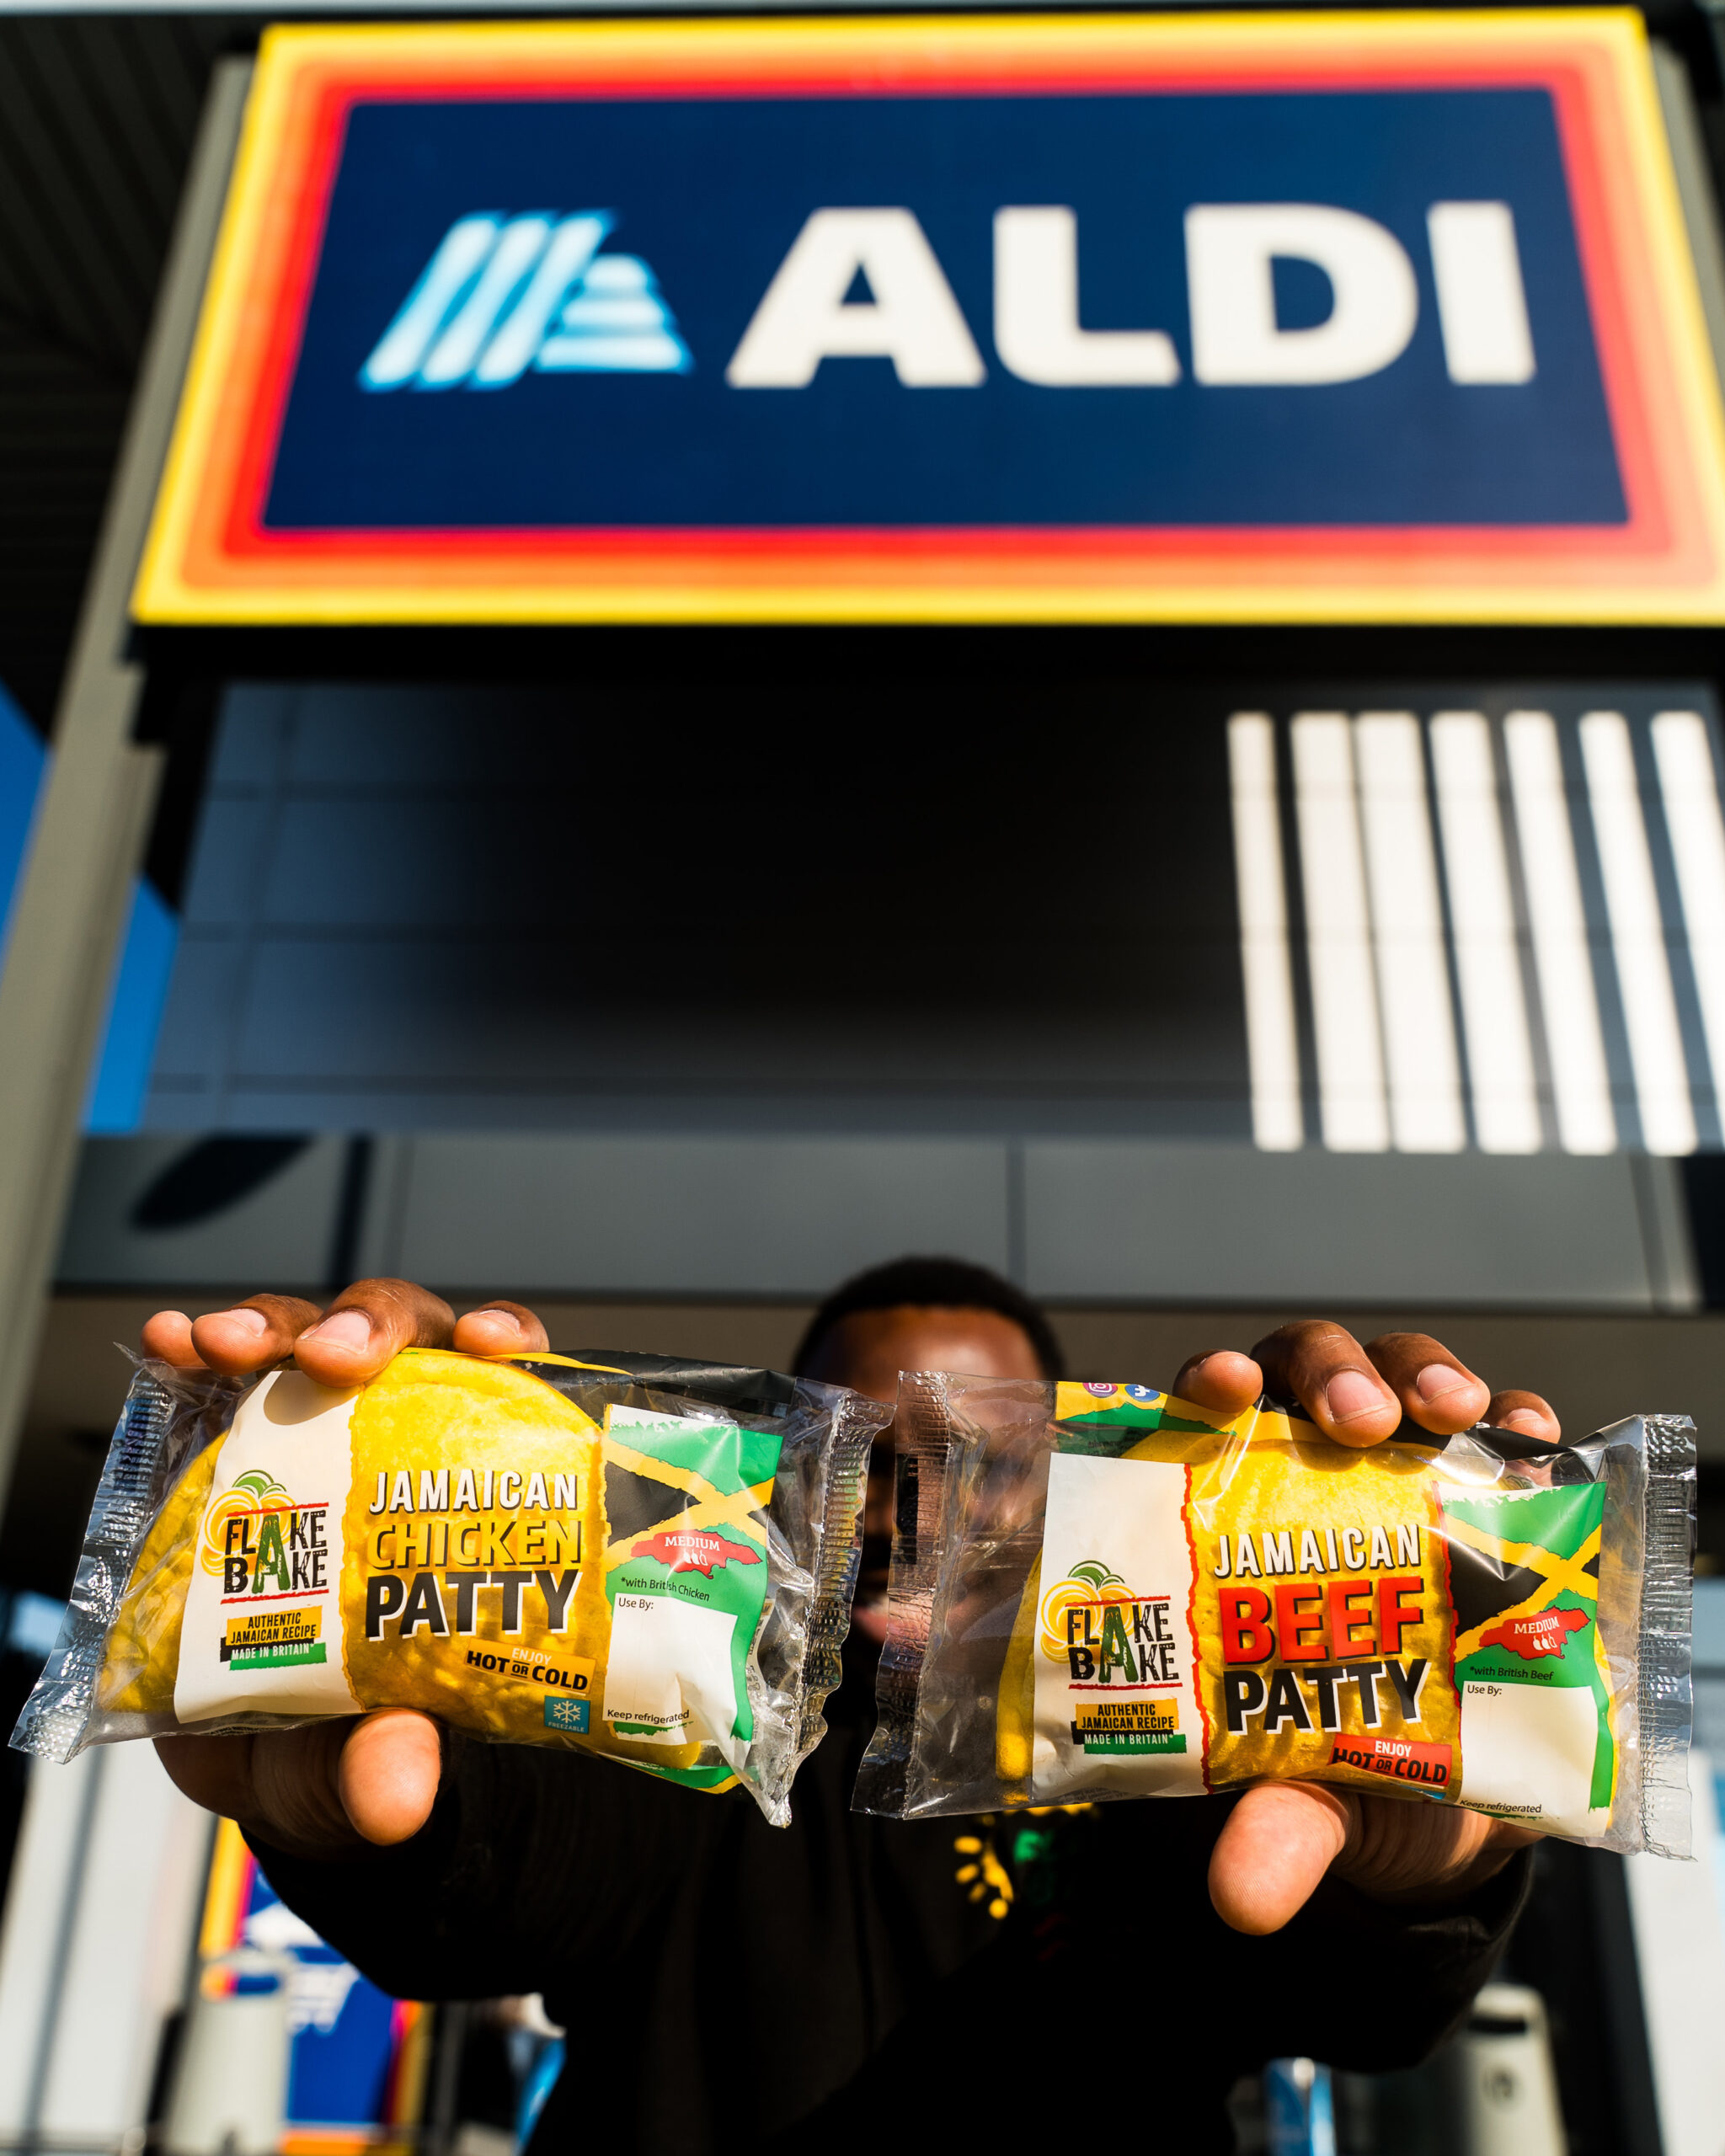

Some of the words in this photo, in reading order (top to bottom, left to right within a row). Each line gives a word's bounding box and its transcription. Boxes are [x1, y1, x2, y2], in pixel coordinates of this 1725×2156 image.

[726, 201, 1536, 388] ALDI
[369, 1469, 578, 1515] JAMAICAN
[224, 1509, 327, 1556] FLAKE
[366, 1520, 581, 1570] CHICKEN
[665, 1535, 720, 1550] MEDIUM
[1214, 1524, 1421, 1579] JAMAICAN
[224, 1548, 328, 1594] BAKE
[649, 1579, 677, 1593] British
[678, 1584, 710, 1602] Chicken
[366, 1569, 583, 1641] PATTY
[618, 1597, 637, 1608] Use
[638, 1598, 654, 1611] By:
[248, 1612, 302, 1629] AUTHENTIC
[1067, 1603, 1173, 1647] FLAKE
[1218, 1575, 1424, 1666] BEEF
[1514, 1616, 1560, 1634] MEDIUM
[231, 1627, 280, 1644] JAMAICAN
[282, 1624, 317, 1640] RECIPE
[231, 1647, 256, 1660] MADE
[259, 1646, 270, 1658] IN
[511, 1647, 552, 1665] ENJOY
[1069, 1642, 1179, 1683] BAKE
[467, 1650, 510, 1673] HOT
[511, 1663, 529, 1676] OR
[531, 1665, 588, 1690] COLD
[1498, 1668, 1529, 1678] British
[1530, 1670, 1554, 1681] Beef
[1223, 1657, 1432, 1736] PATTY
[1467, 1684, 1485, 1694] Use
[1487, 1685, 1503, 1697] By:
[607, 1709, 633, 1721] Keep
[634, 1709, 690, 1725] refrigerated
[1097, 1704, 1156, 1716] AUTHENTIC
[547, 1721, 585, 1732] FREEZABLE
[1081, 1716, 1134, 1729] JAMAICAN
[1137, 1716, 1175, 1728] RECIPE
[1084, 1733, 1111, 1745] MADE
[1115, 1733, 1125, 1745] IN
[1375, 1740, 1412, 1758] ENJOY
[1332, 1747, 1375, 1769] HOT
[1375, 1758, 1392, 1771] OR
[1394, 1758, 1447, 1783] COLD
[1460, 1799, 1485, 1809] Keep
[1486, 1802, 1542, 1813] refrigerated
